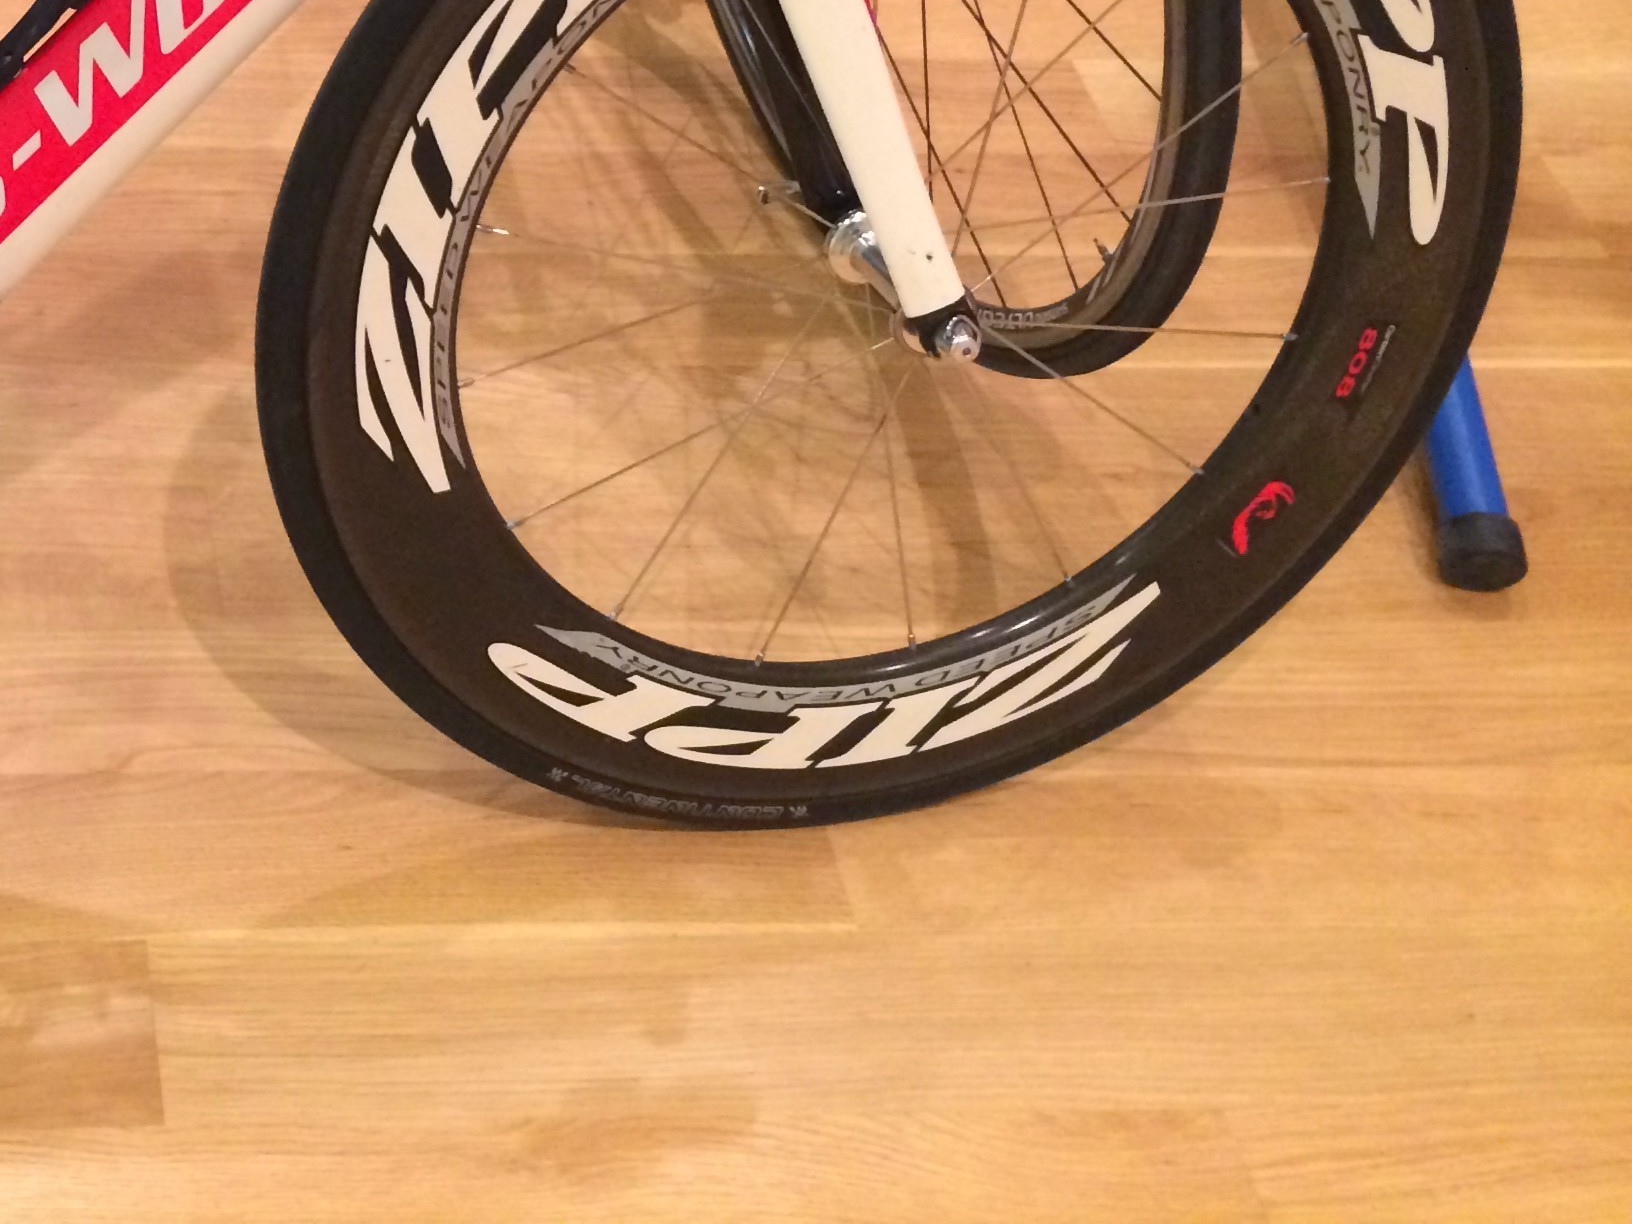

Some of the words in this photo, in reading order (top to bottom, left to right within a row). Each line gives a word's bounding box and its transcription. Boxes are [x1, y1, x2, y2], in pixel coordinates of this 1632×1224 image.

[1335, 327, 1378, 398] 808
[486, 581, 1162, 770] ZIPP
[596, 643, 897, 701] WEAPONRY
